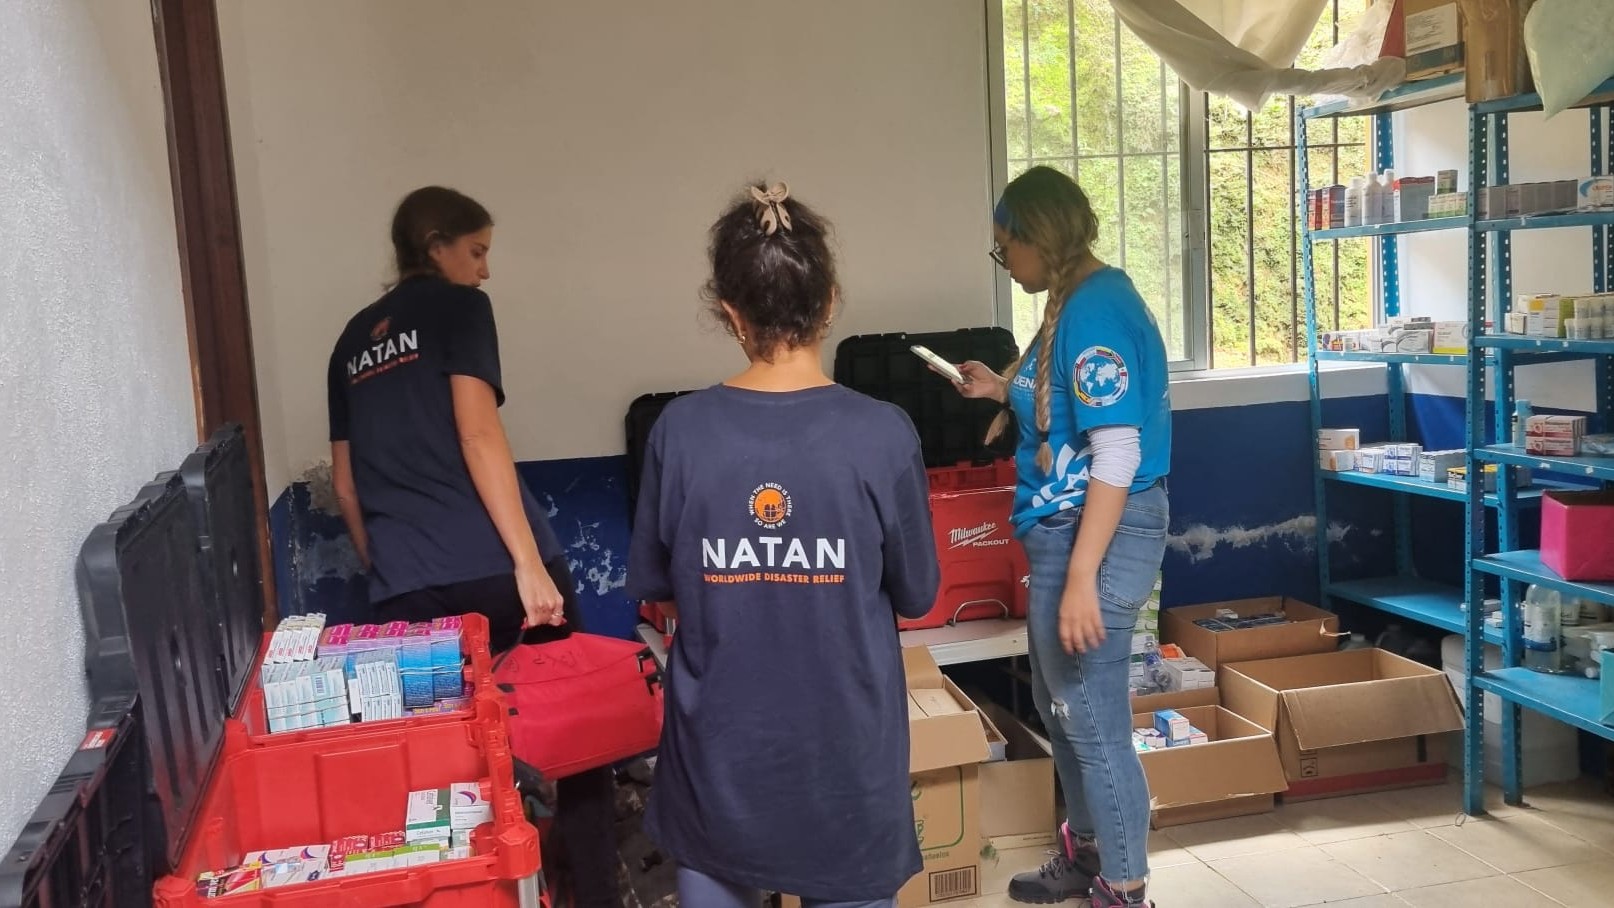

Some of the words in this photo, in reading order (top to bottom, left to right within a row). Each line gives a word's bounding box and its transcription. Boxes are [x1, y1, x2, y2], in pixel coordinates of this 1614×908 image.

[346, 329, 418, 376] NATAN
[748, 494, 756, 516] WHEN
[752, 484, 764, 495] THE
[765, 482, 782, 491] NEED
[781, 488, 788, 496] IS
[785, 495, 793, 517] THERE
[753, 517, 763, 526] SO
[775, 518, 787, 528] WE
[947, 522, 997, 544] Milwaukee
[702, 536, 846, 569] NATAN
[972, 538, 1010, 548] PACKOUT
[703, 573, 762, 584] WORLDWIDE
[764, 573, 810, 584] DISASTER
[812, 574, 845, 584] RELIEF
